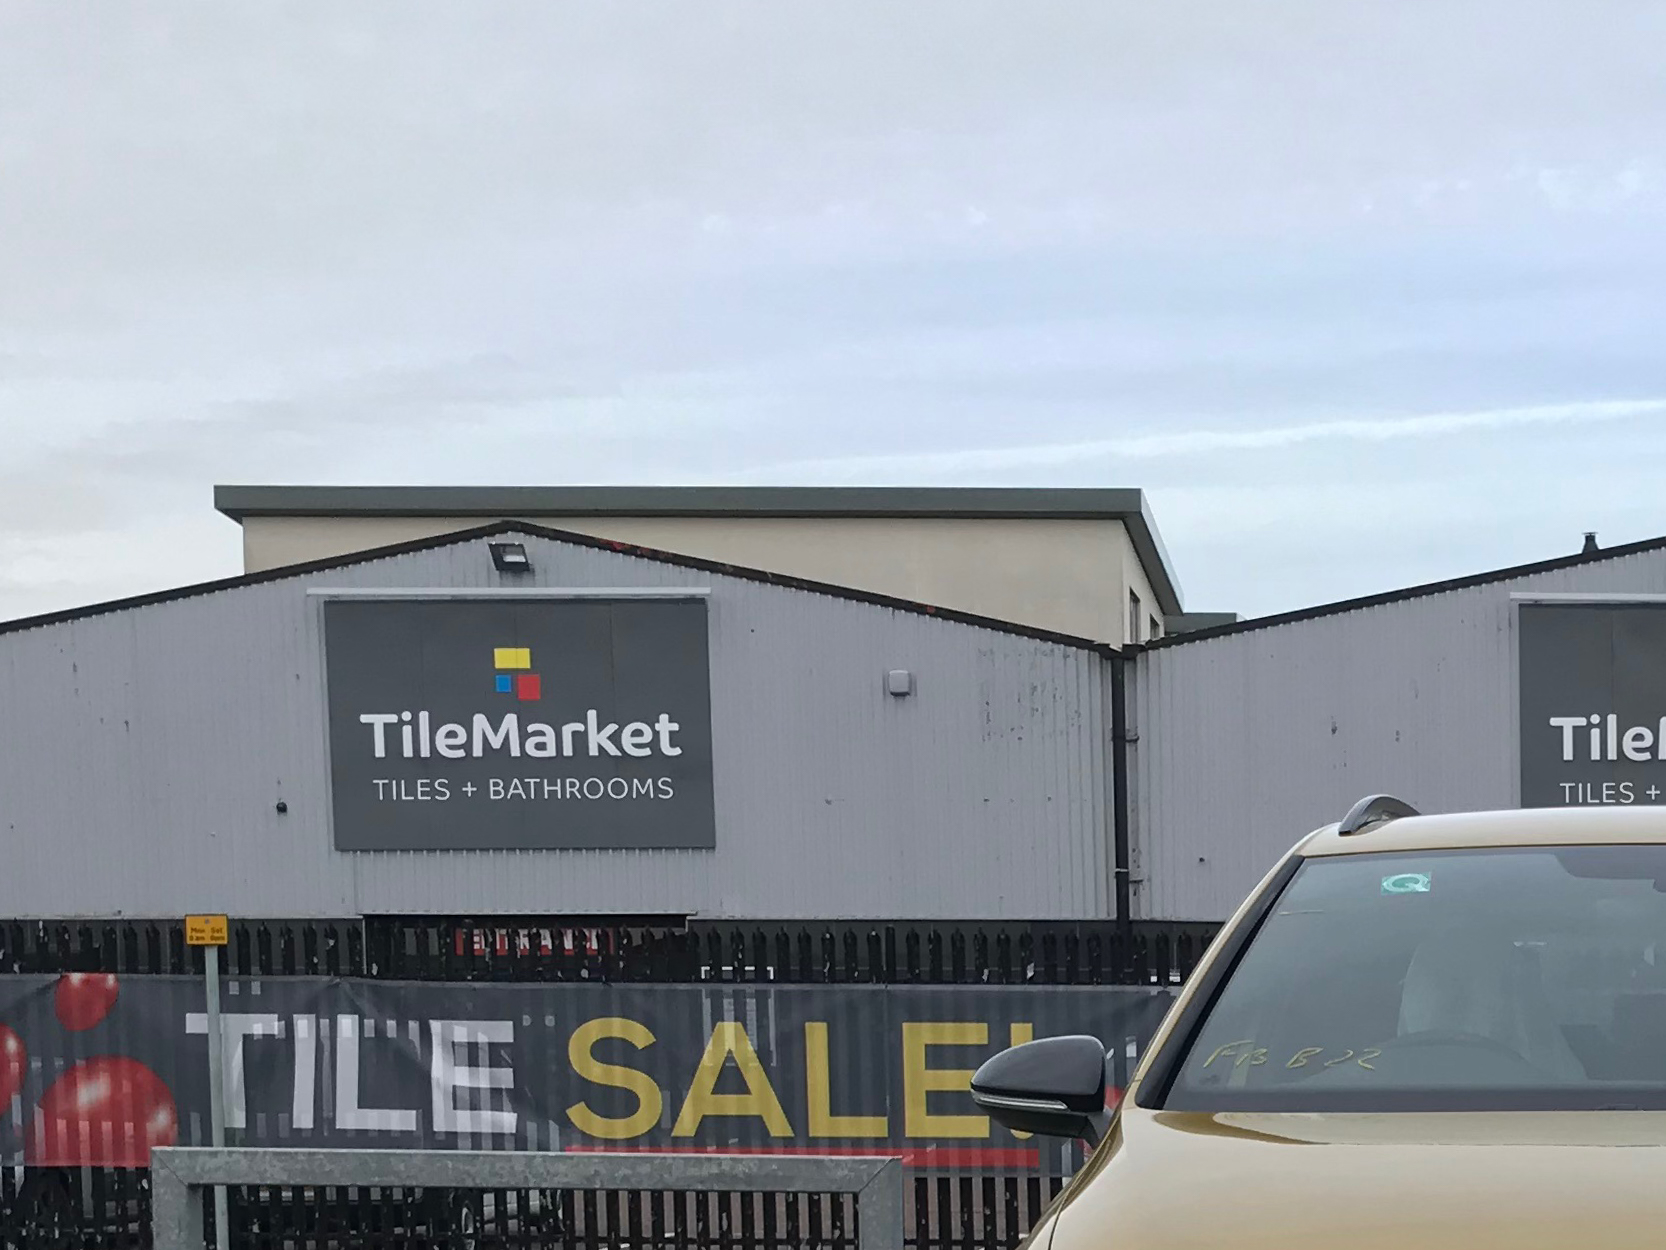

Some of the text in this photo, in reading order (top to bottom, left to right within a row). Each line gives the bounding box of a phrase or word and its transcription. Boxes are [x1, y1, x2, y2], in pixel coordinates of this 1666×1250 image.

[361, 710, 682, 759] TileMarket
[373, 778, 674, 801] TILES + BATHROOMS
[1561, 782, 1634, 804] TILES
[1646, 785, 1661, 801] +
[186, 1013, 517, 1133] TILE
